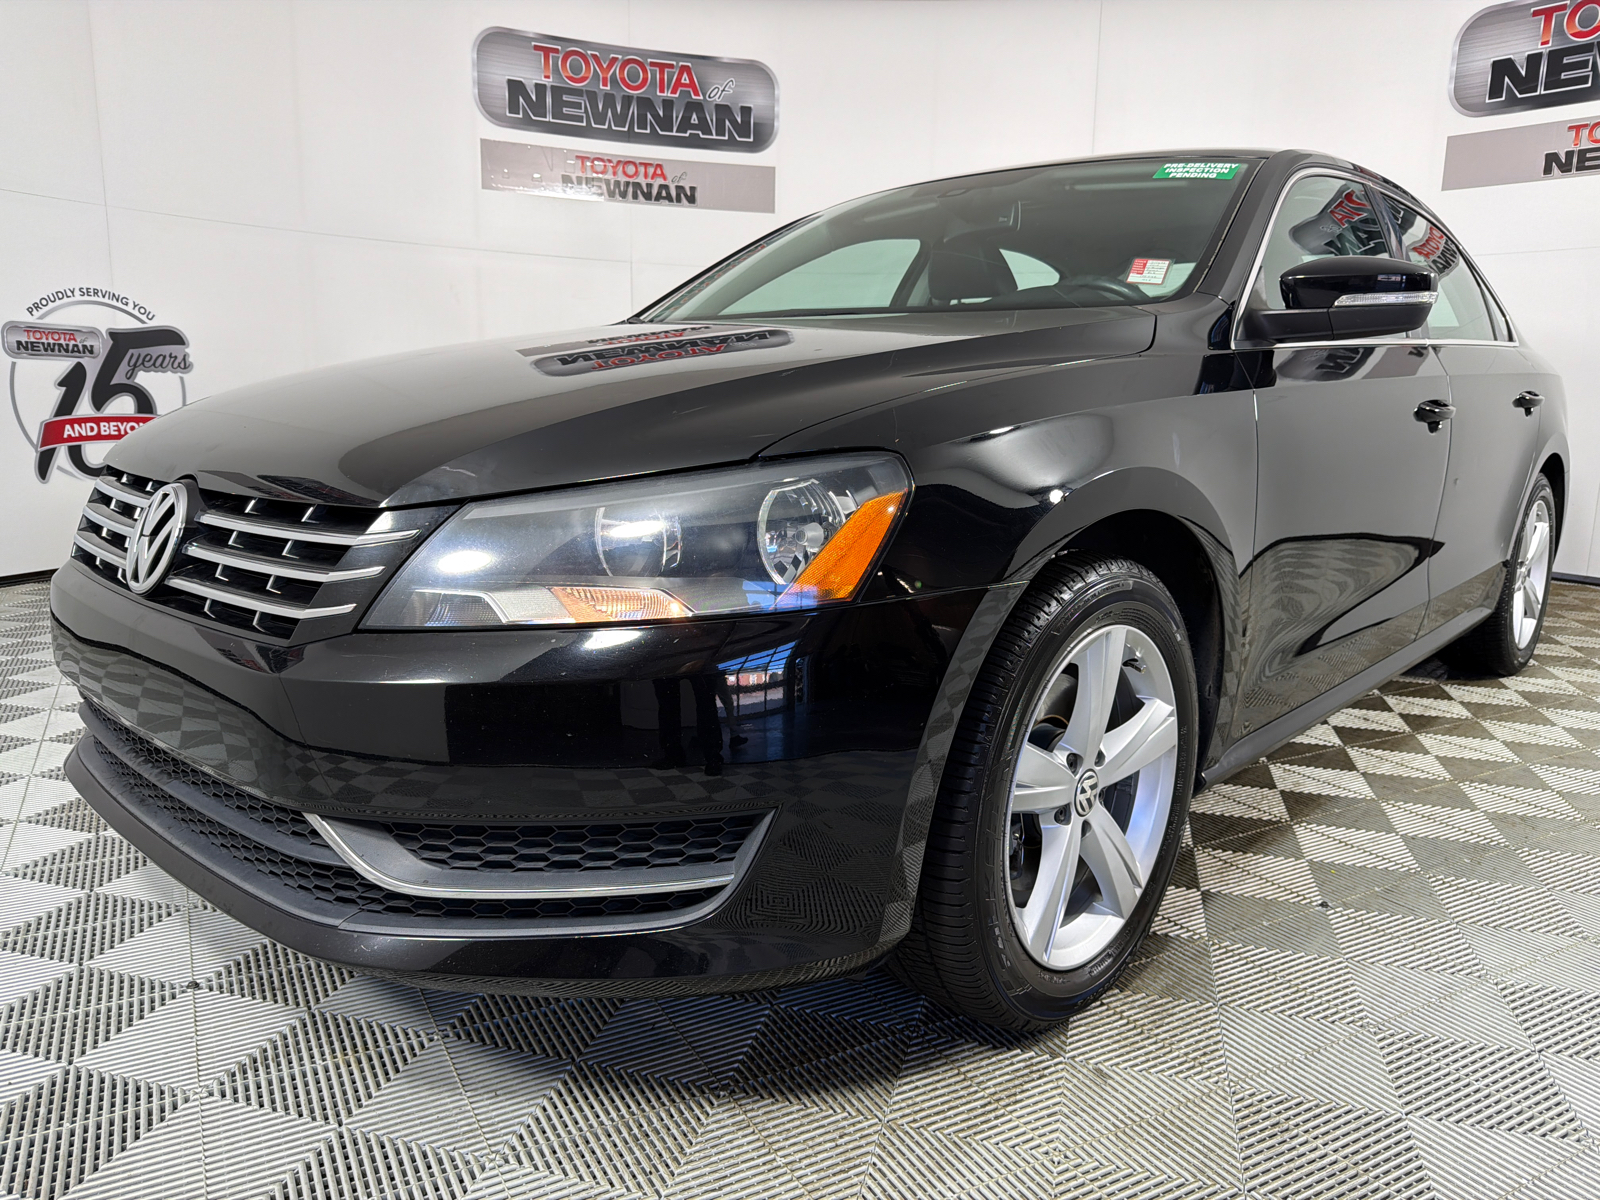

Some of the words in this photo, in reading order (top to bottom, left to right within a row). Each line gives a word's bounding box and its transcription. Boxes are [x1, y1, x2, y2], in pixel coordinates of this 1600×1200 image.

[1531, 0, 1600, 48] TO
[532, 42, 701, 99] TOYOTA
[707, 78, 735, 101] of
[1486, 41, 1600, 102] NE
[506, 77, 753, 141] NEWNAN
[575, 155, 667, 182] TOYOTA
[671, 172, 687, 183] of
[561, 174, 697, 204] NEWNAN
[26, 287, 75, 316] PROUDLY
[79, 287, 129, 306] SERVING
[132, 301, 156, 321] YOU
[16, 340, 94, 355] NEWNAN
[23, 329, 77, 343] TOYOTA
[125, 352, 191, 380] years
[38, 328, 186, 481] 15
[63, 422, 98, 438] AND
[100, 422, 147, 435] BEYO
